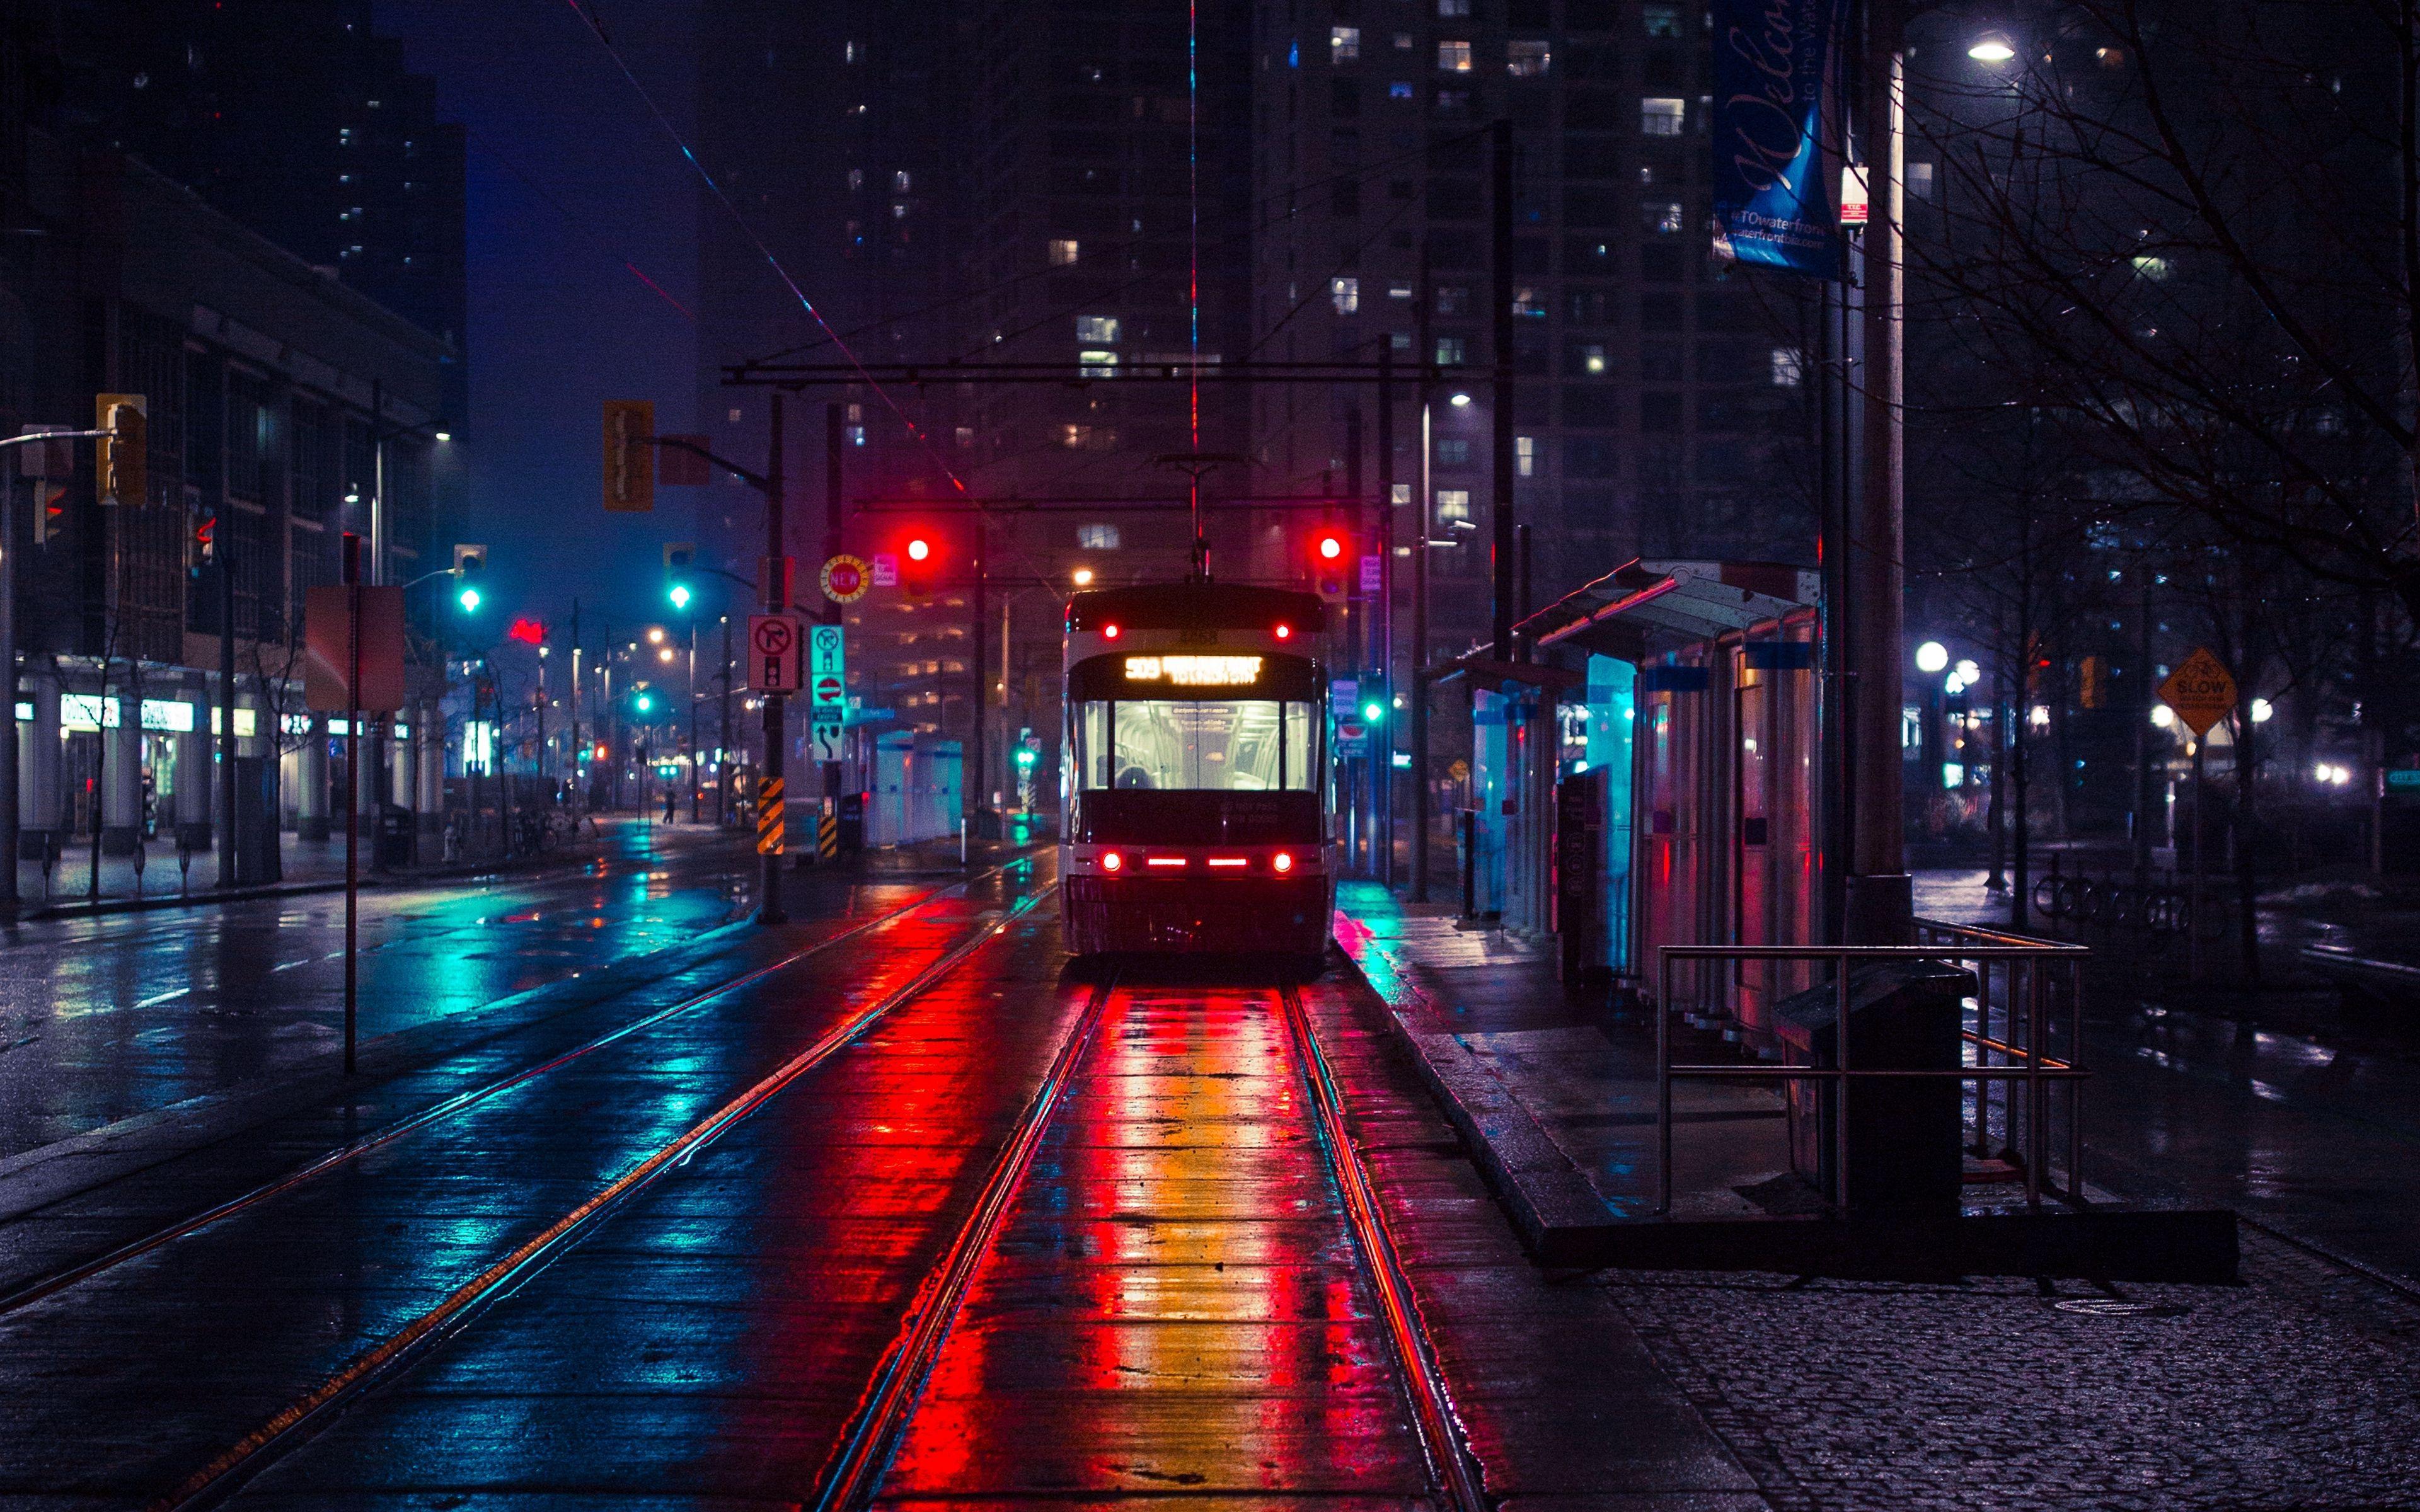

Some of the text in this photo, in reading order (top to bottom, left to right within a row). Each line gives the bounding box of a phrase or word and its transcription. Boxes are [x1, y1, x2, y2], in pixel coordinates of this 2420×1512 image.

[830, 571, 858, 586] NEW
[1126, 657, 1161, 679] 509
[2178, 680, 2226, 694] SLOW
